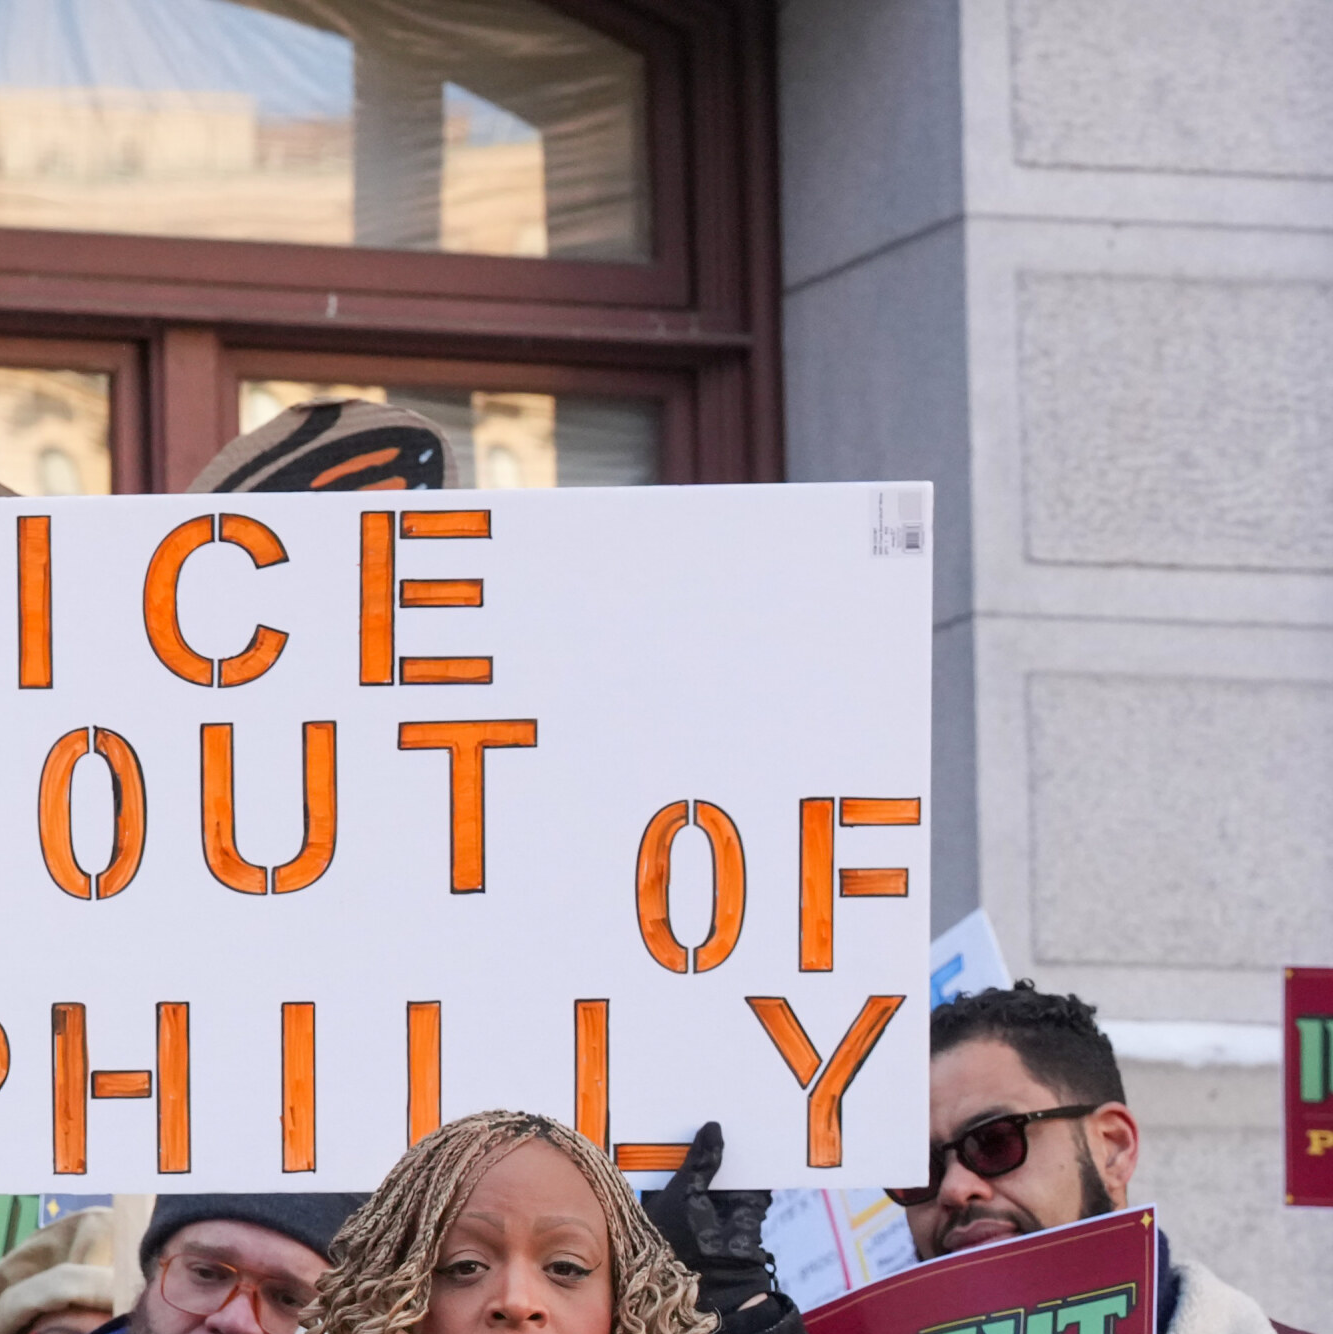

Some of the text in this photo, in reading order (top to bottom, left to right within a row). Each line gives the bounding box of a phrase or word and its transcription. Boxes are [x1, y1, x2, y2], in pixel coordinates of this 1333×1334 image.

[16, 508, 493, 689] ICE
[37, 718, 538, 900] OUT
[635, 797, 921, 974] OF
